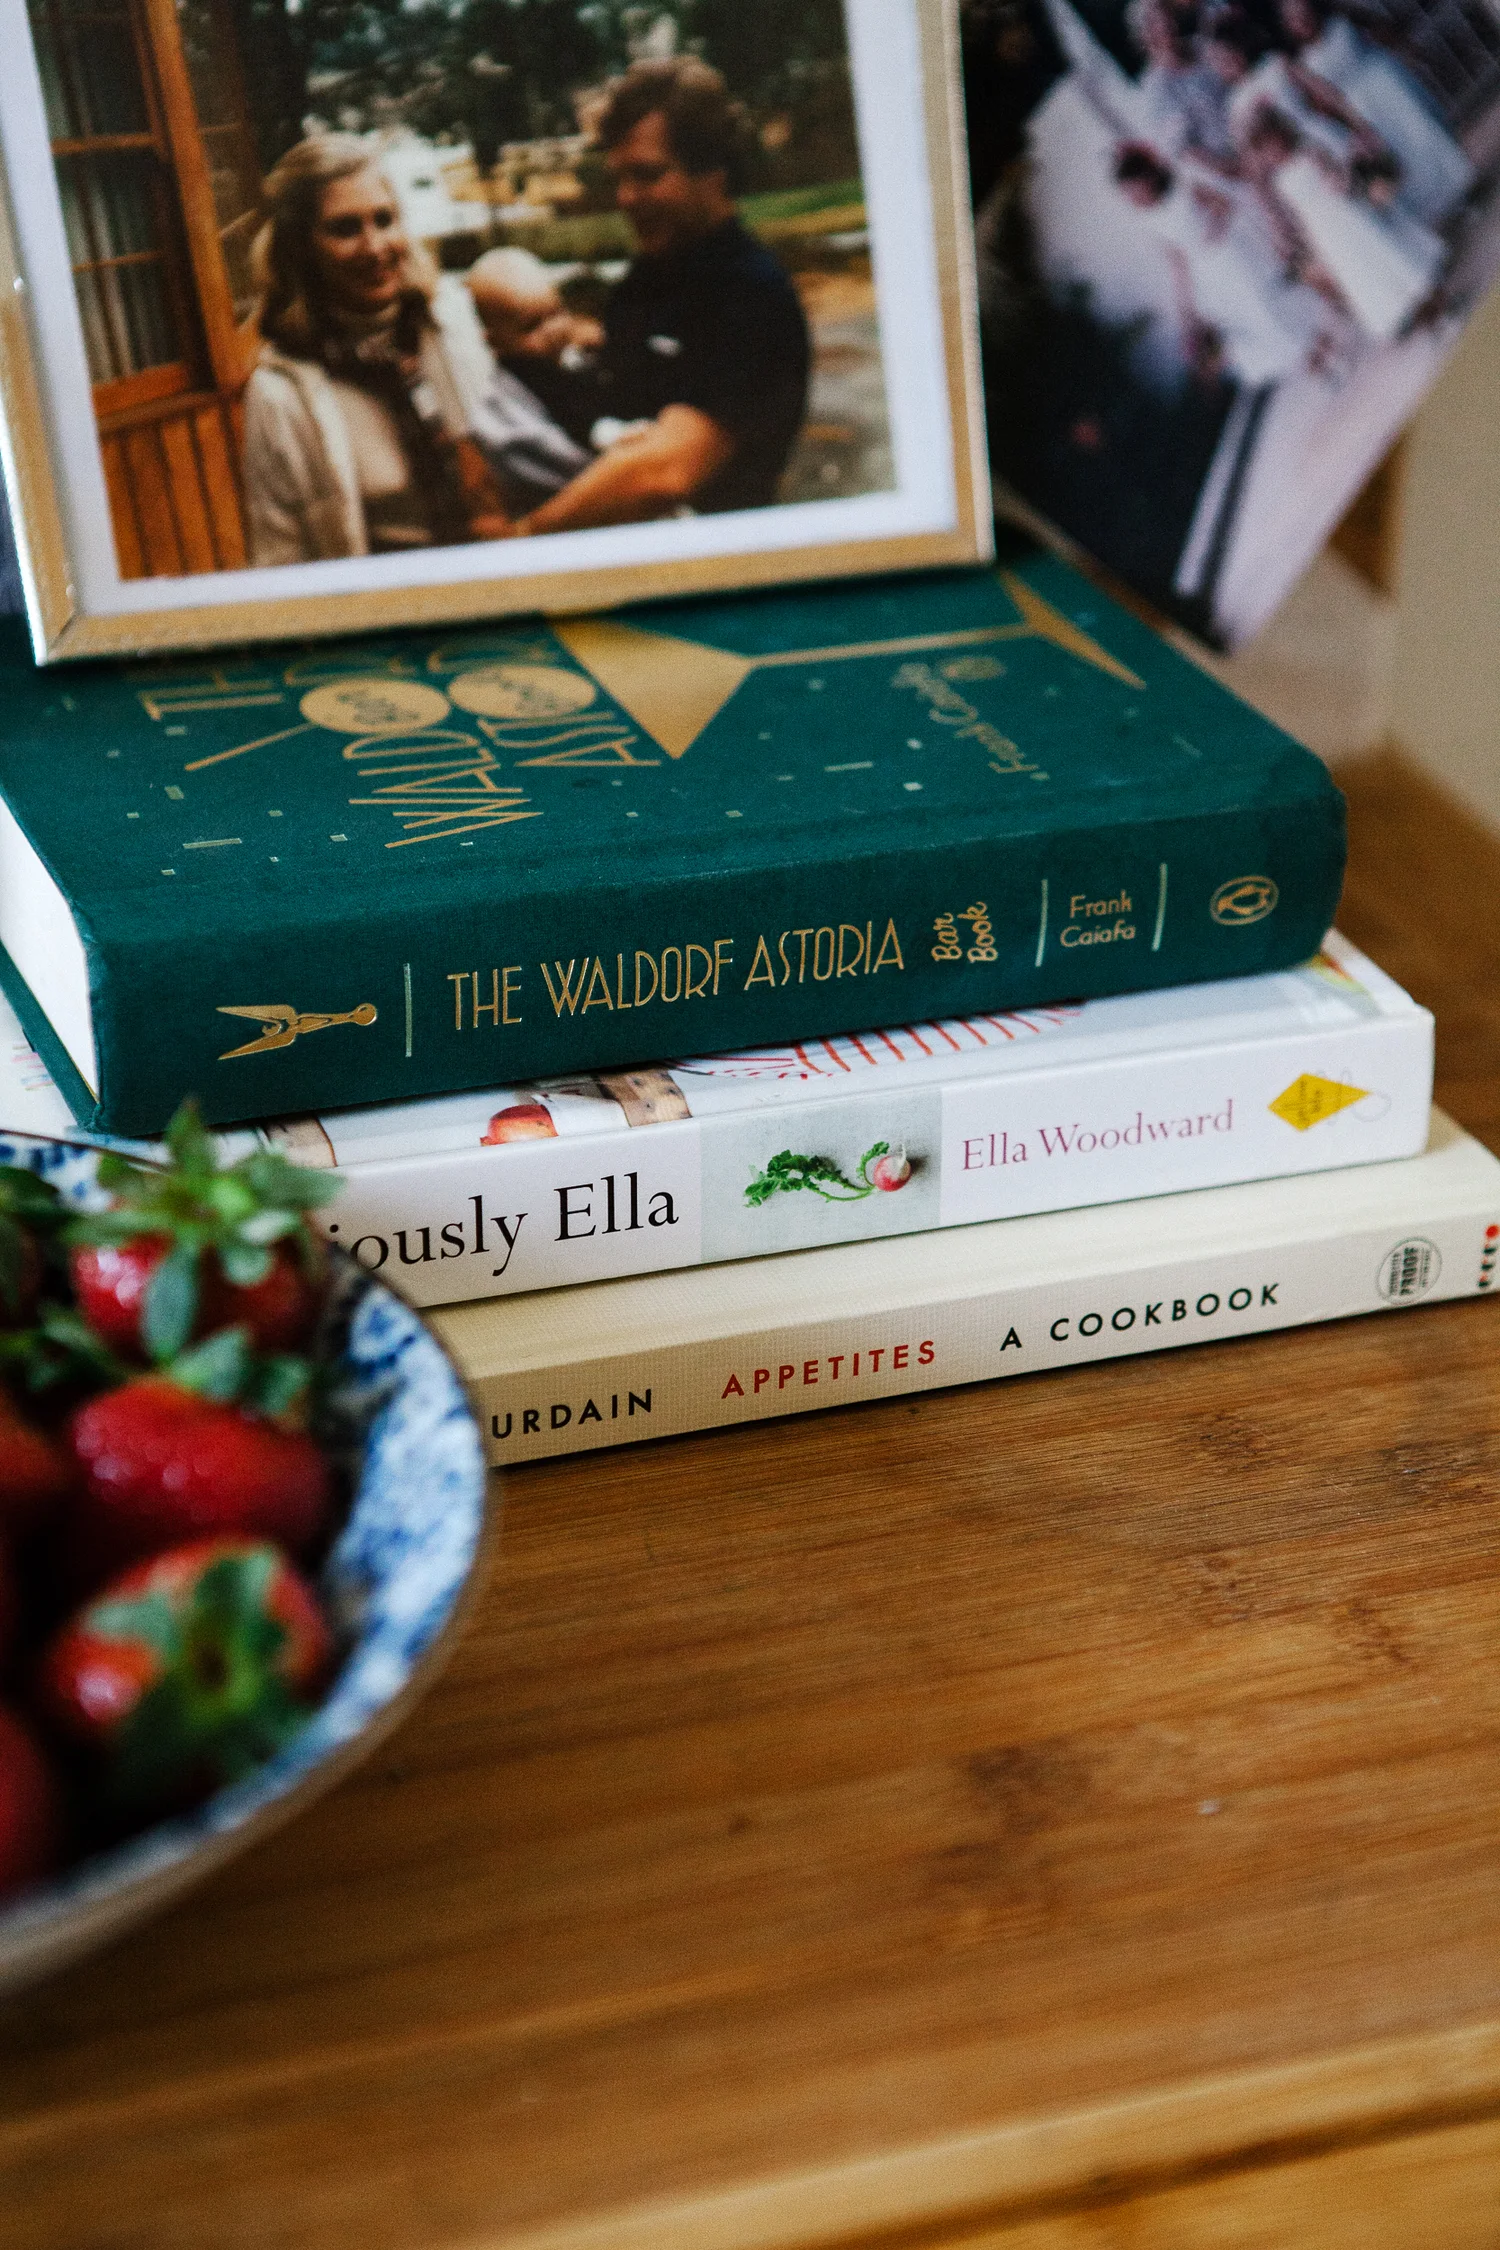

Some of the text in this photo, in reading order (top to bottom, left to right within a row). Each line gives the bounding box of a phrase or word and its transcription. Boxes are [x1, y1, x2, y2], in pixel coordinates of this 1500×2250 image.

[957, 901, 998, 964] Book
[1059, 919, 1137, 948] Caiafa
[1069, 889, 1133, 919] Frank
[931, 912, 962, 962] Bar
[447, 917, 905, 1030] THE WALDORF ASTORIA
[962, 1131, 1029, 1170] Ella
[1036, 1098, 1233, 1157] Woodward
[553, 1171, 680, 1242] Ella
[1399, 1247, 1419, 1296] PROOF
[721, 1340, 935, 1400] APPETITES
[1000, 1327, 1023, 1352] A
[1049, 1283, 1280, 1342] COOKBOOK
